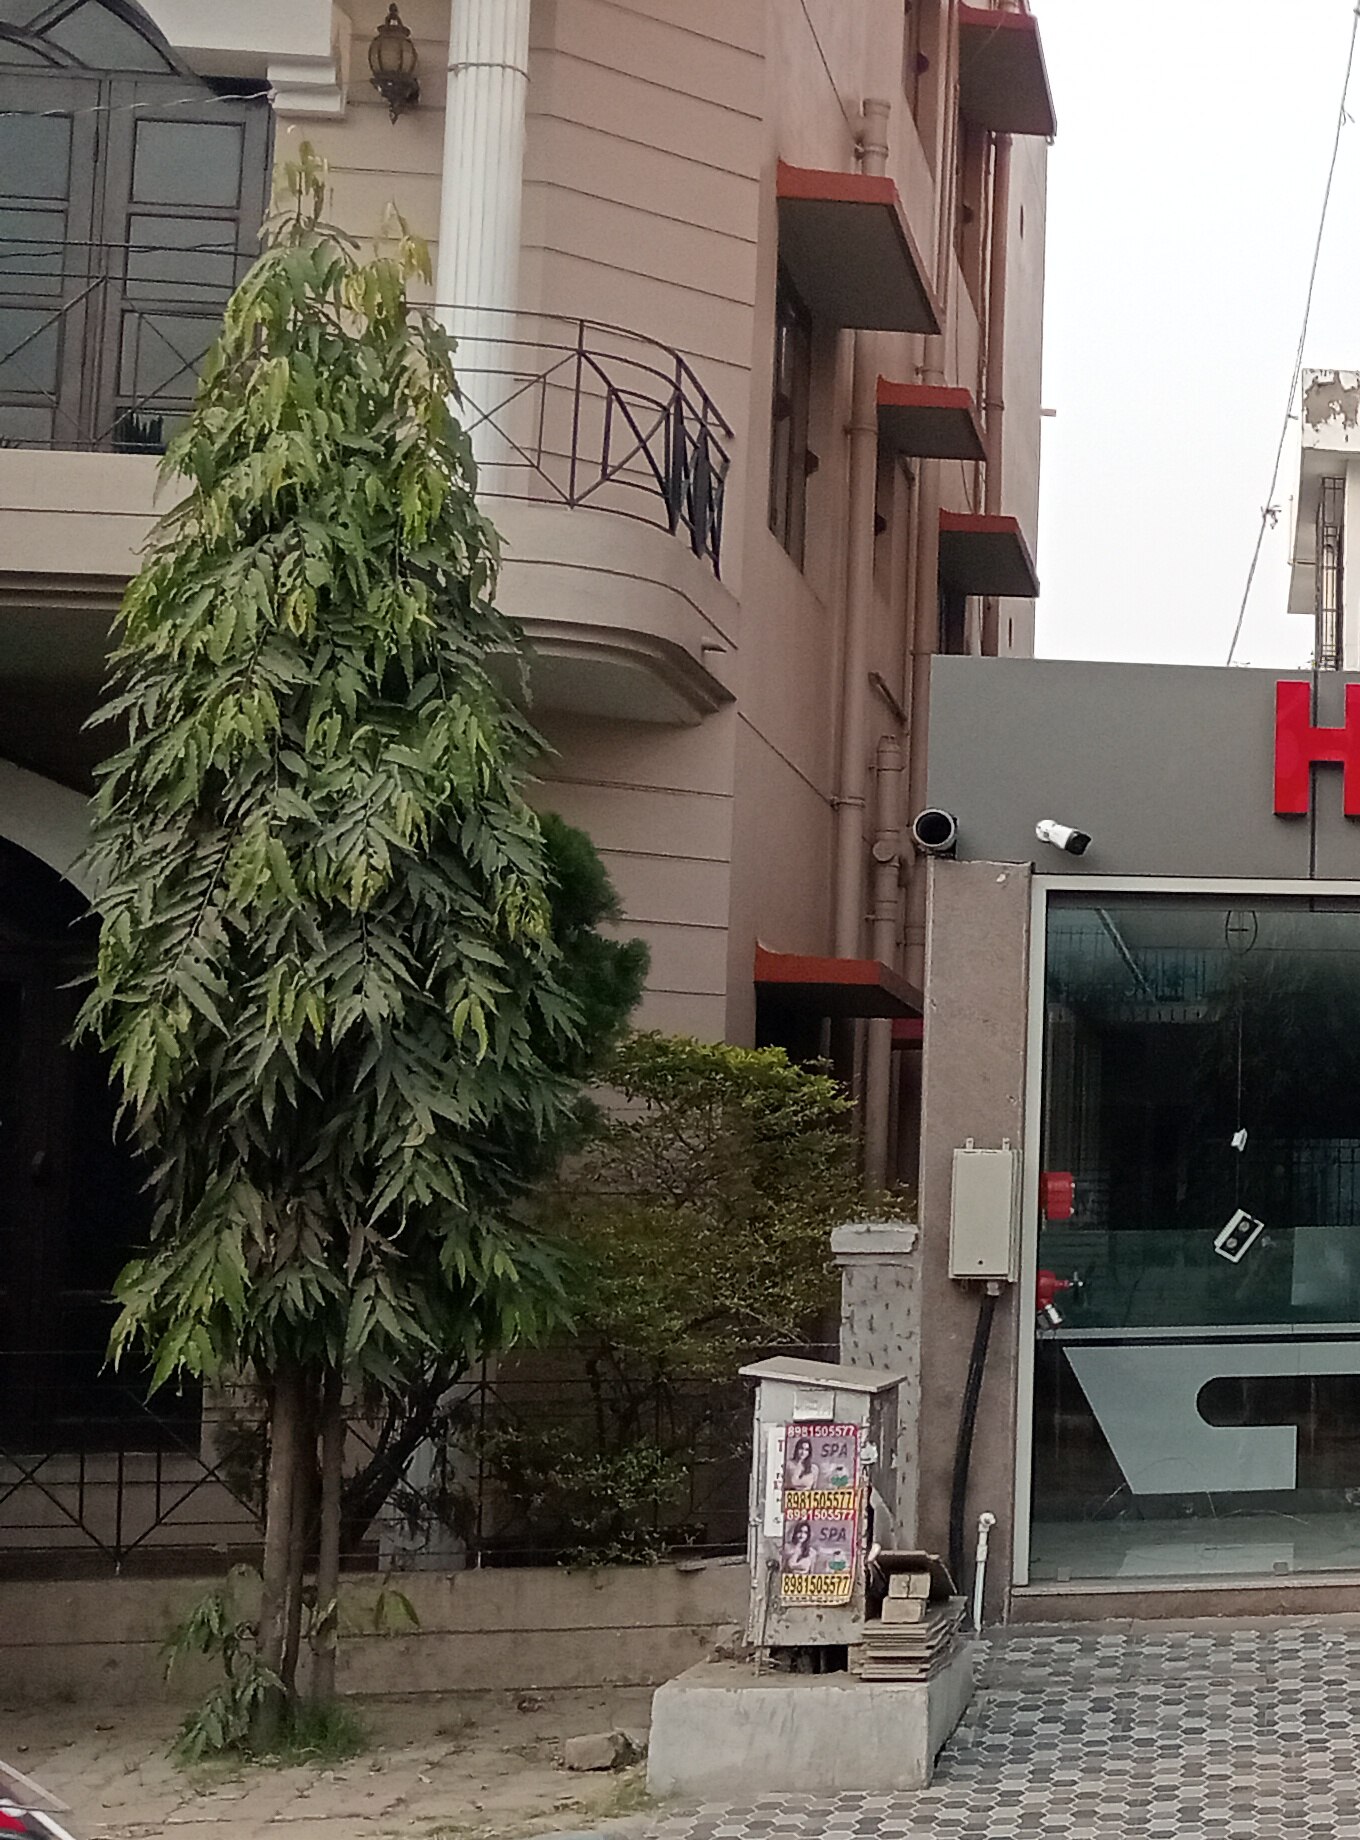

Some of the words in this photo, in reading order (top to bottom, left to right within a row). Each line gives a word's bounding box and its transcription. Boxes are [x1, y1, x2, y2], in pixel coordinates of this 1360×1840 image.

[787, 1425, 855, 1438] 8981505577
[821, 1443, 848, 1458] SPA
[786, 1491, 853, 1509] 8981505577
[819, 1527, 847, 1542] SPA
[783, 1575, 850, 1594] 8981505577
